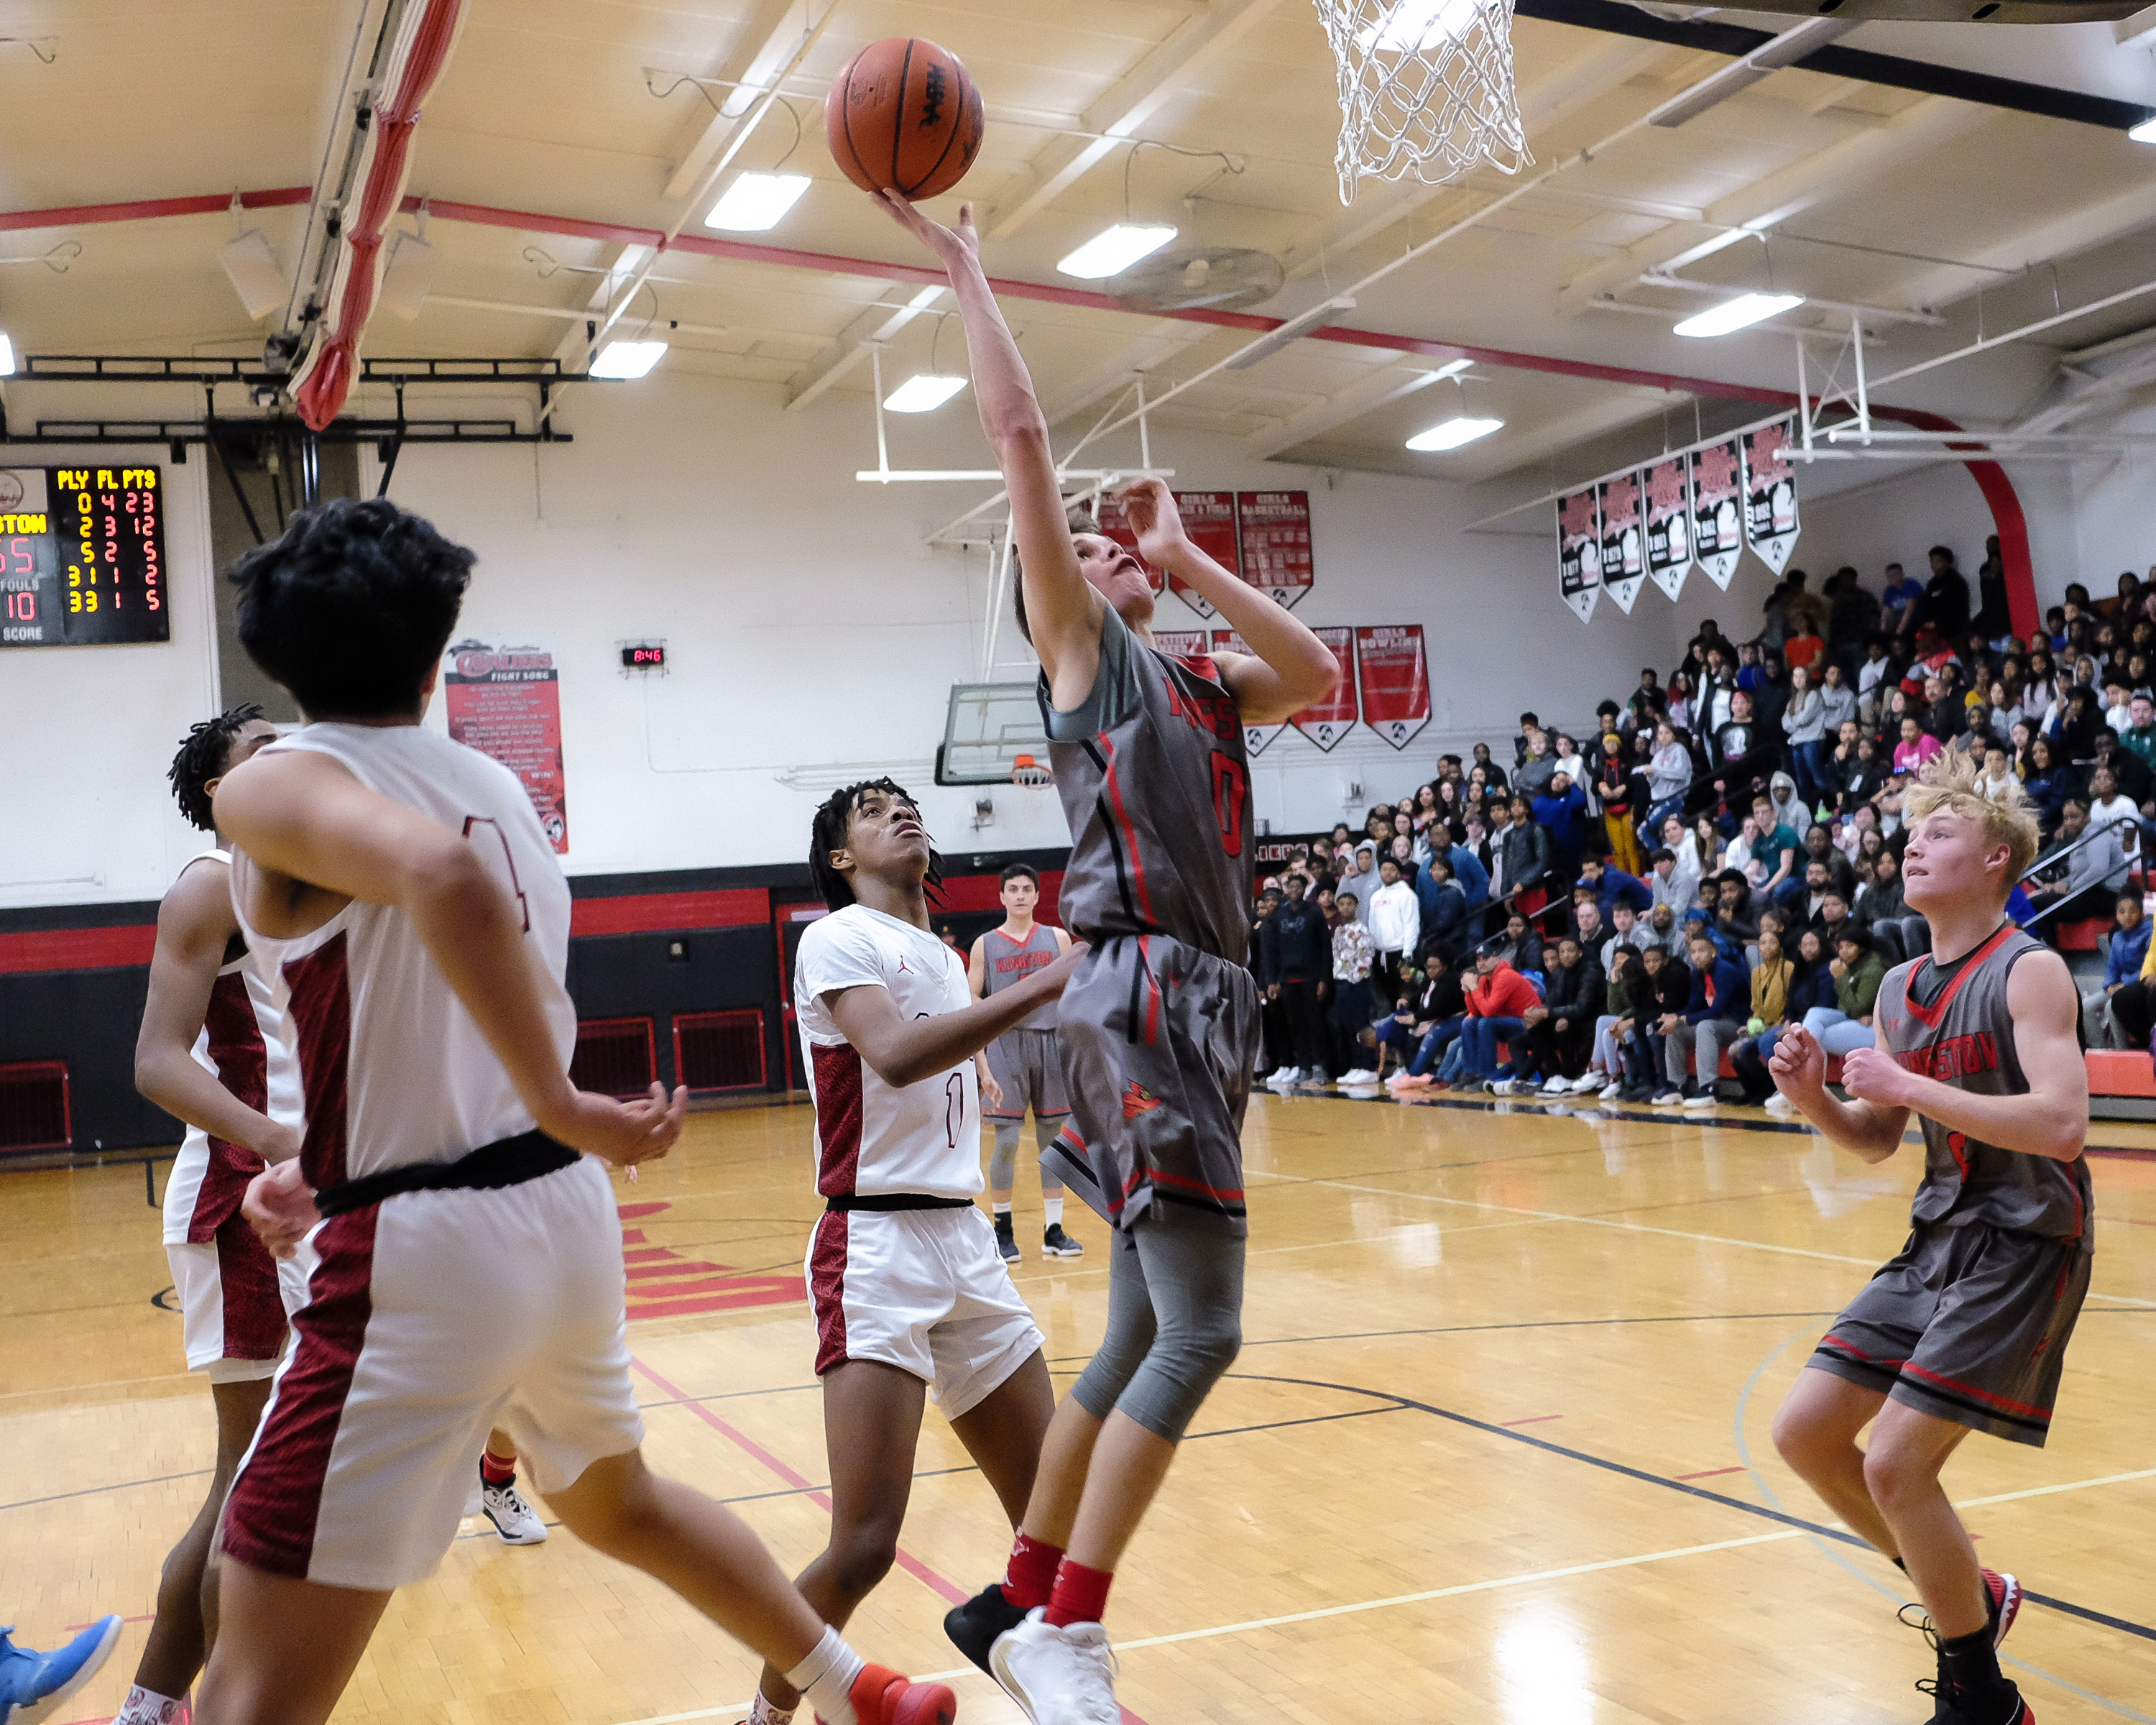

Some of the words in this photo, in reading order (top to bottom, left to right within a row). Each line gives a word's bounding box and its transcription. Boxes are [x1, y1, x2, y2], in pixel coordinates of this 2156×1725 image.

[57, 470, 89, 489] PLY
[97, 470, 119, 489] FL
[122, 469, 156, 489] PTS
[78, 492, 92, 514] 0
[101, 494, 115, 511] 4
[125, 492, 154, 513] 23
[80, 516, 93, 538] 2
[104, 515, 116, 537] 3
[134, 515, 155, 537] 12
[80, 541, 95, 563] 5
[104, 541, 118, 563] 2
[143, 540, 157, 561] 5
[114, 566, 119, 584] 1
[145, 564, 158, 584] 2
[8, 592, 36, 621] 10
[70, 590, 98, 612] 33
[115, 592, 121, 609] 1
[146, 589, 160, 611] 5
[3, 625, 44, 641] SCORE
[634, 649, 661, 663] 8:46
[491, 671, 520, 682] FIGHT
[522, 671, 548, 681] SONG
[1211, 750, 1246, 857] 0
[1893, 1032, 1999, 1082] INGSTON
